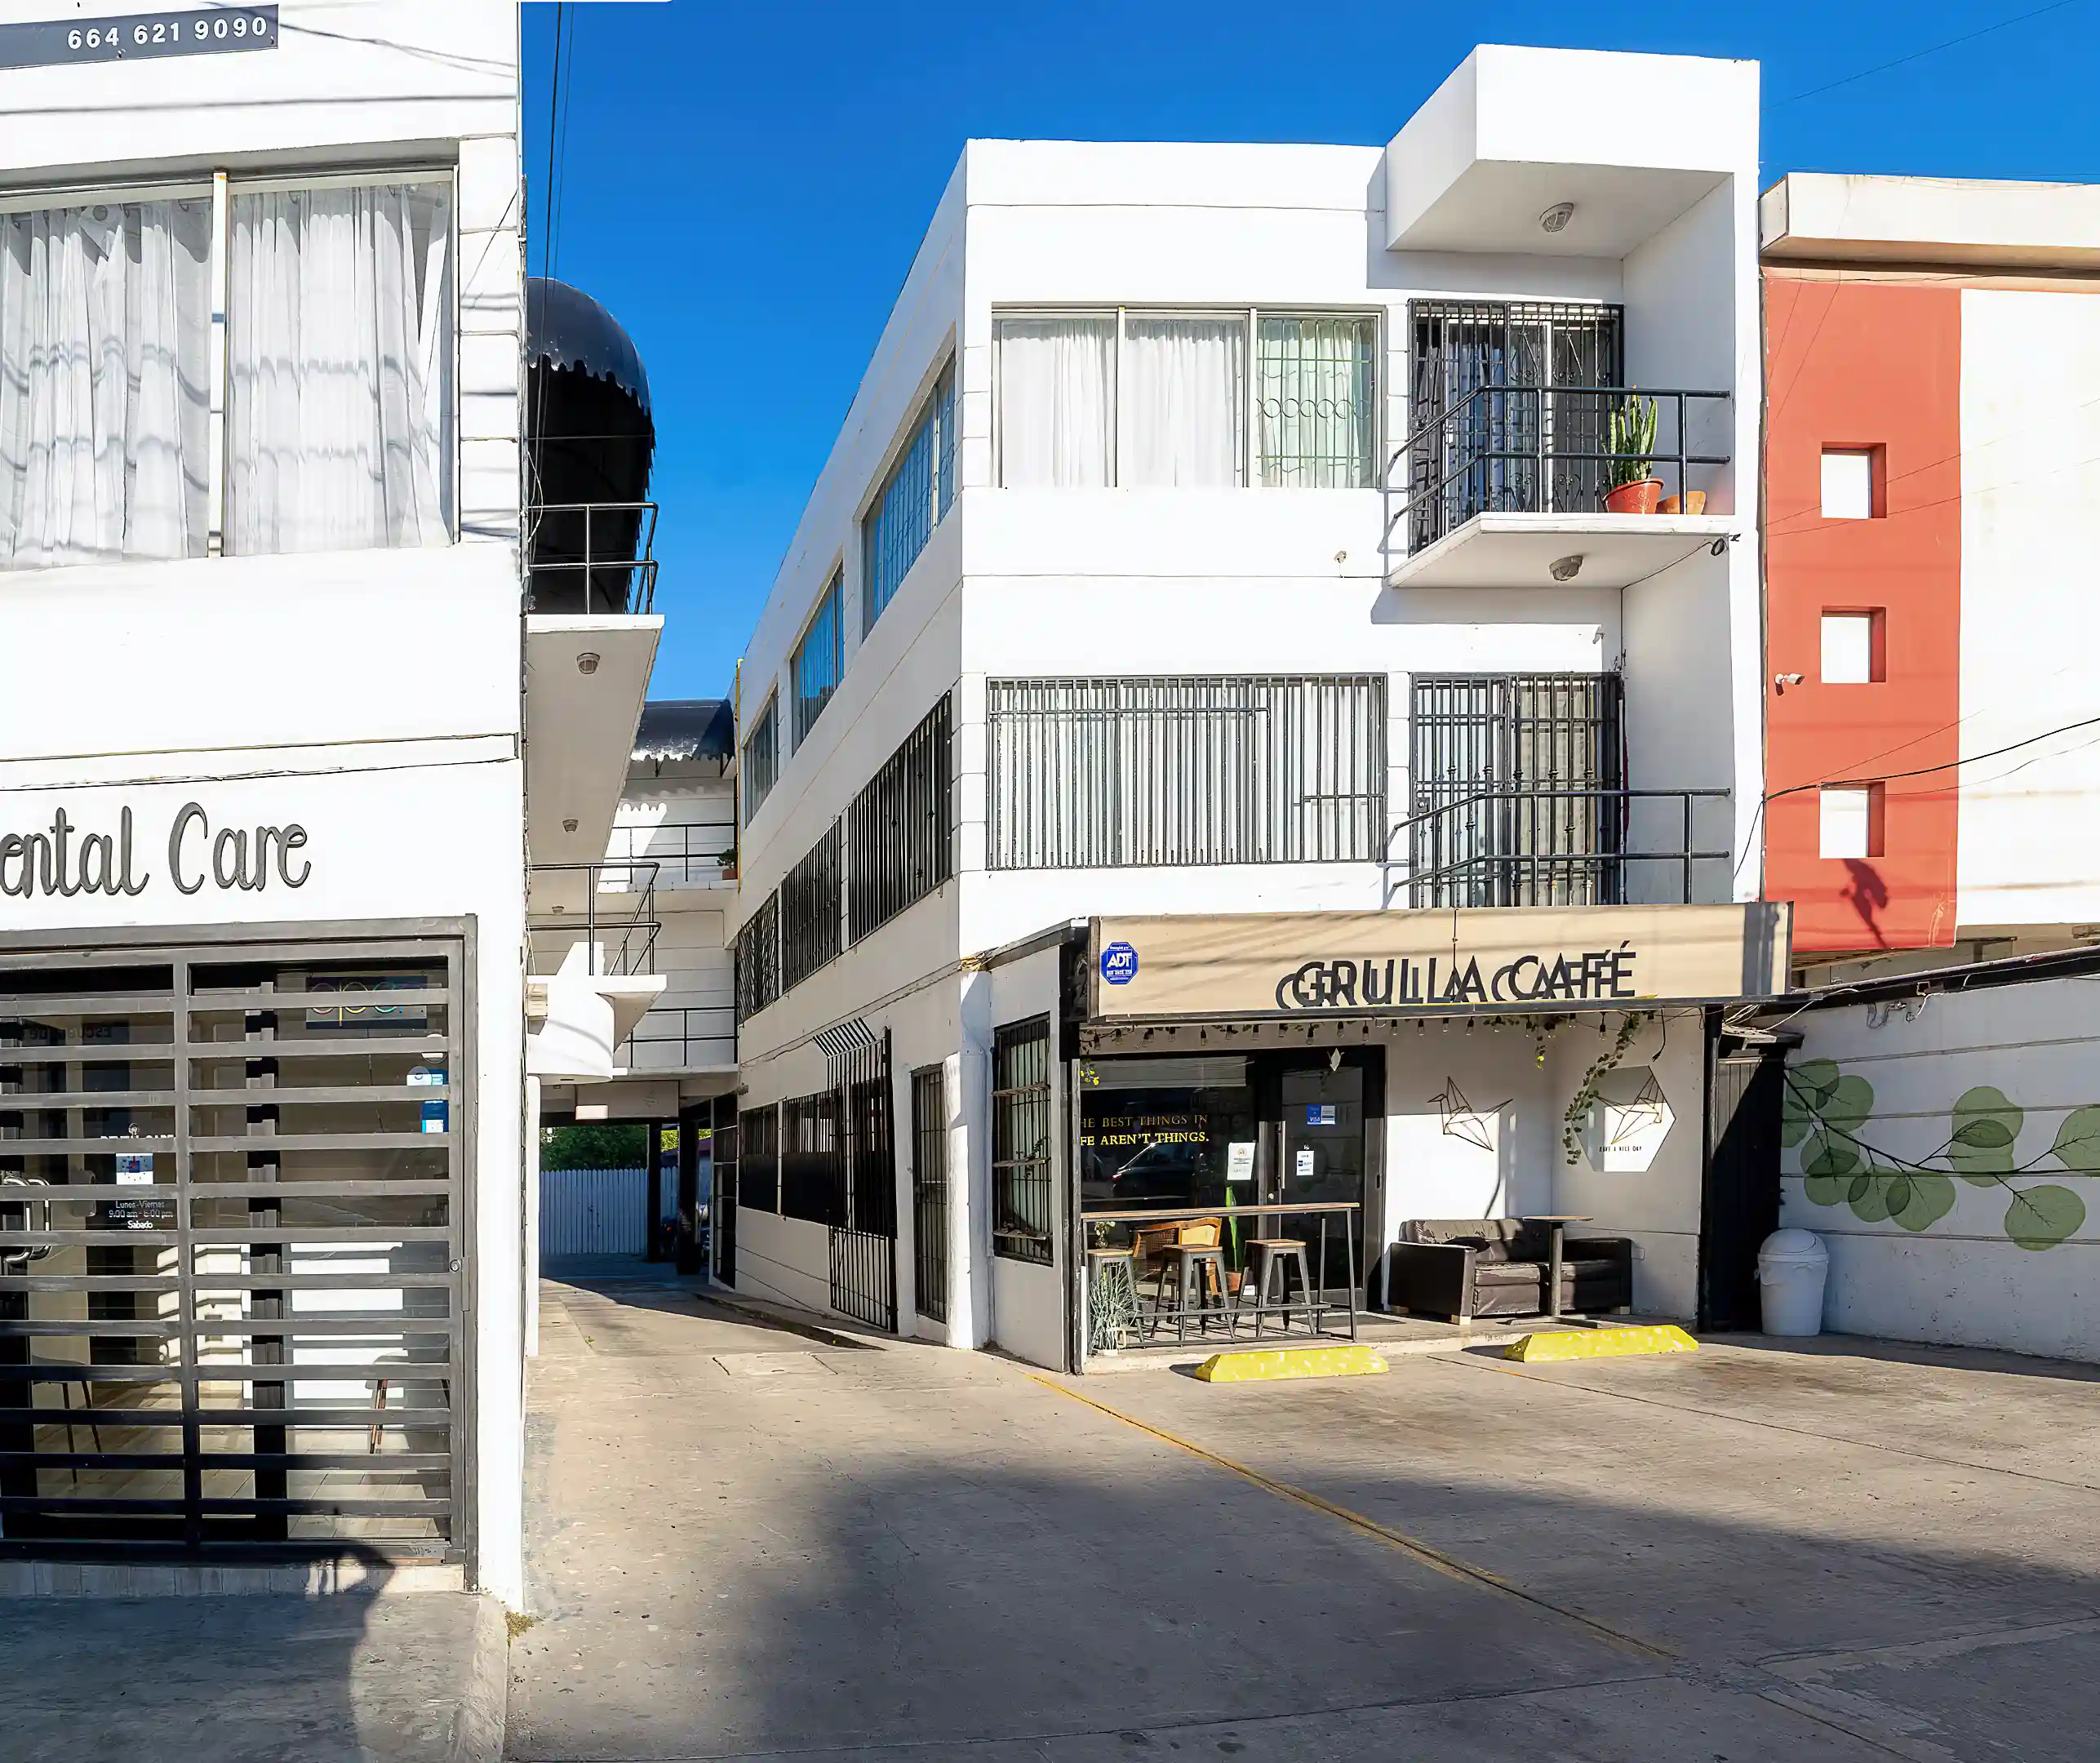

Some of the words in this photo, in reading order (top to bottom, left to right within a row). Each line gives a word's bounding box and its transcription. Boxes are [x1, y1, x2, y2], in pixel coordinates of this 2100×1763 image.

[68, 27, 119, 49] 664
[134, 22, 180, 44] 621
[194, 16, 267, 40] 9090
[0, 805, 149, 898] ental
[169, 802, 311, 895] Care
[1107, 953, 1130, 967] ADT
[1288, 955, 1487, 1007] GRULLA
[1507, 940, 1636, 1001] CAFÉ
[1081, 1117, 1095, 1128] HE
[1103, 1117, 1133, 1127] BEST
[1139, 1115, 1188, 1126] THINGS
[1194, 1114, 1208, 1124] IN
[1080, 1135, 1095, 1146] FE
[1154, 1131, 1210, 1143] THINGS.
